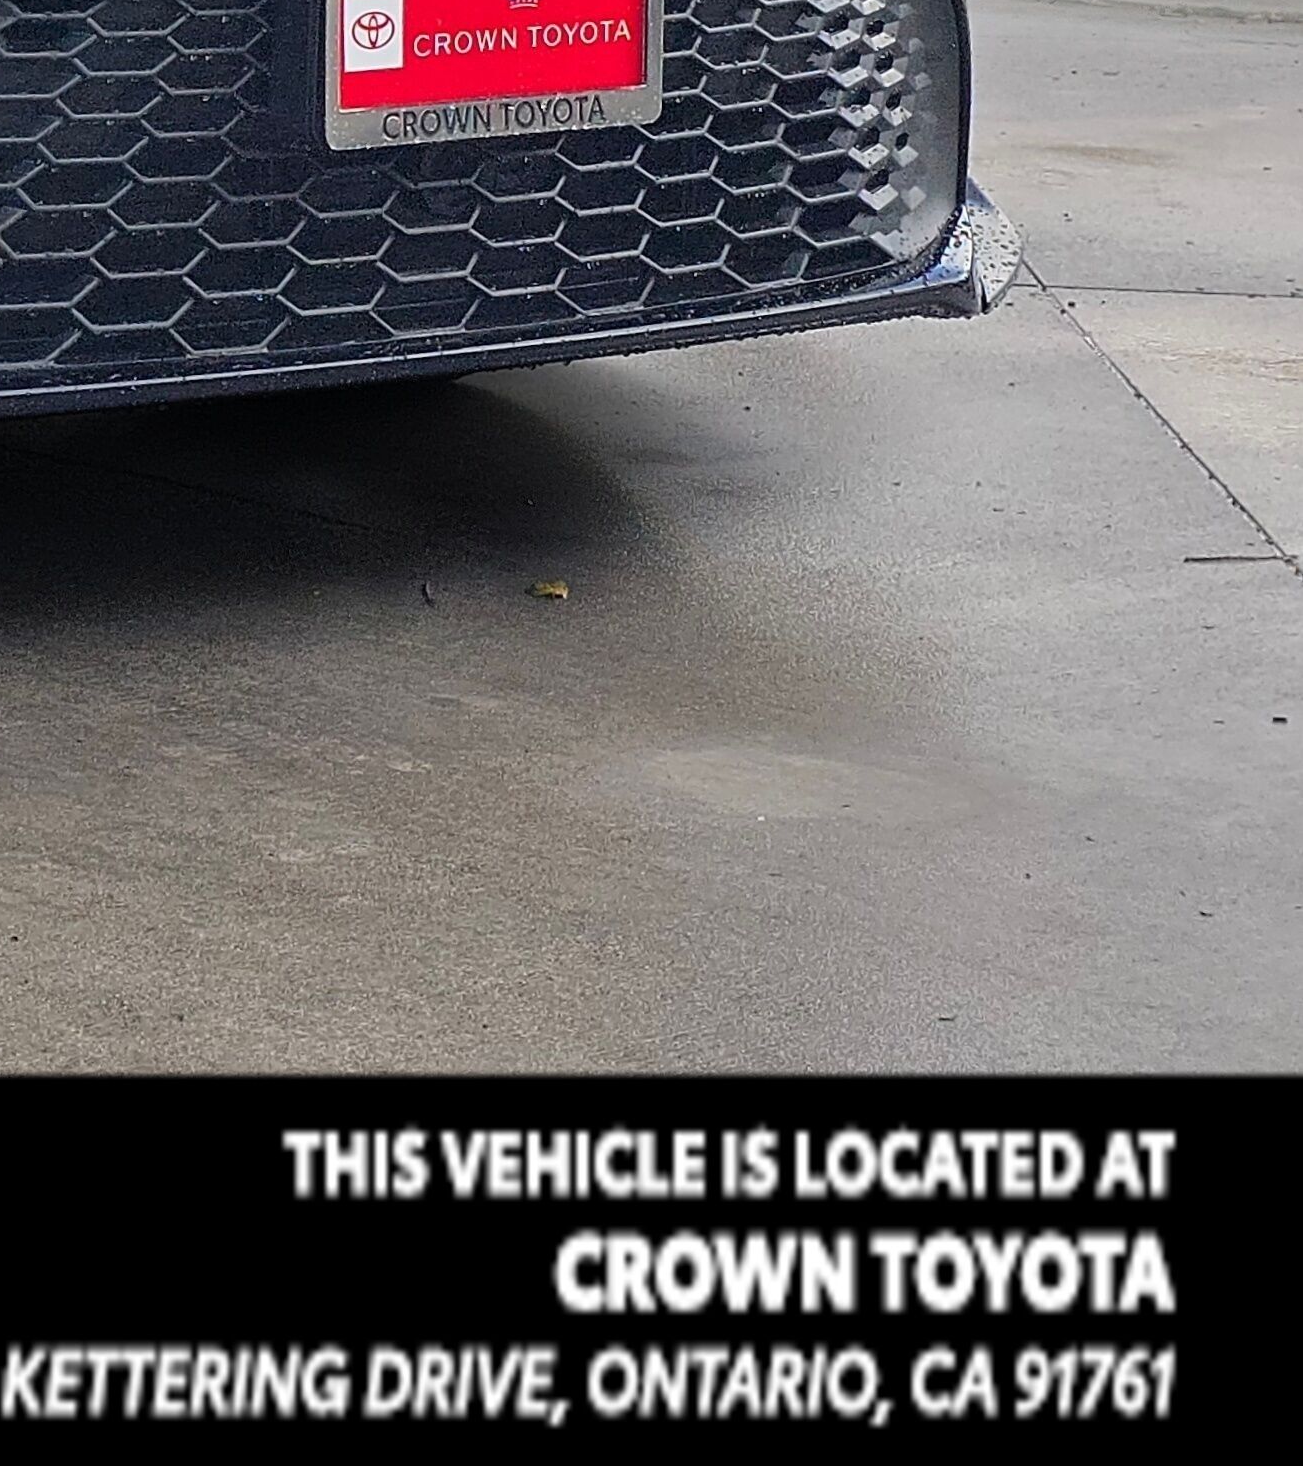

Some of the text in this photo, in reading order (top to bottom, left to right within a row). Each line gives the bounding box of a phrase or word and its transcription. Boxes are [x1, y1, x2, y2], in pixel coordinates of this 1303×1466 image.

[413, 18, 632, 59] CROWN TOYOTA
[382, 94, 608, 140] CROWN TOYOTA
